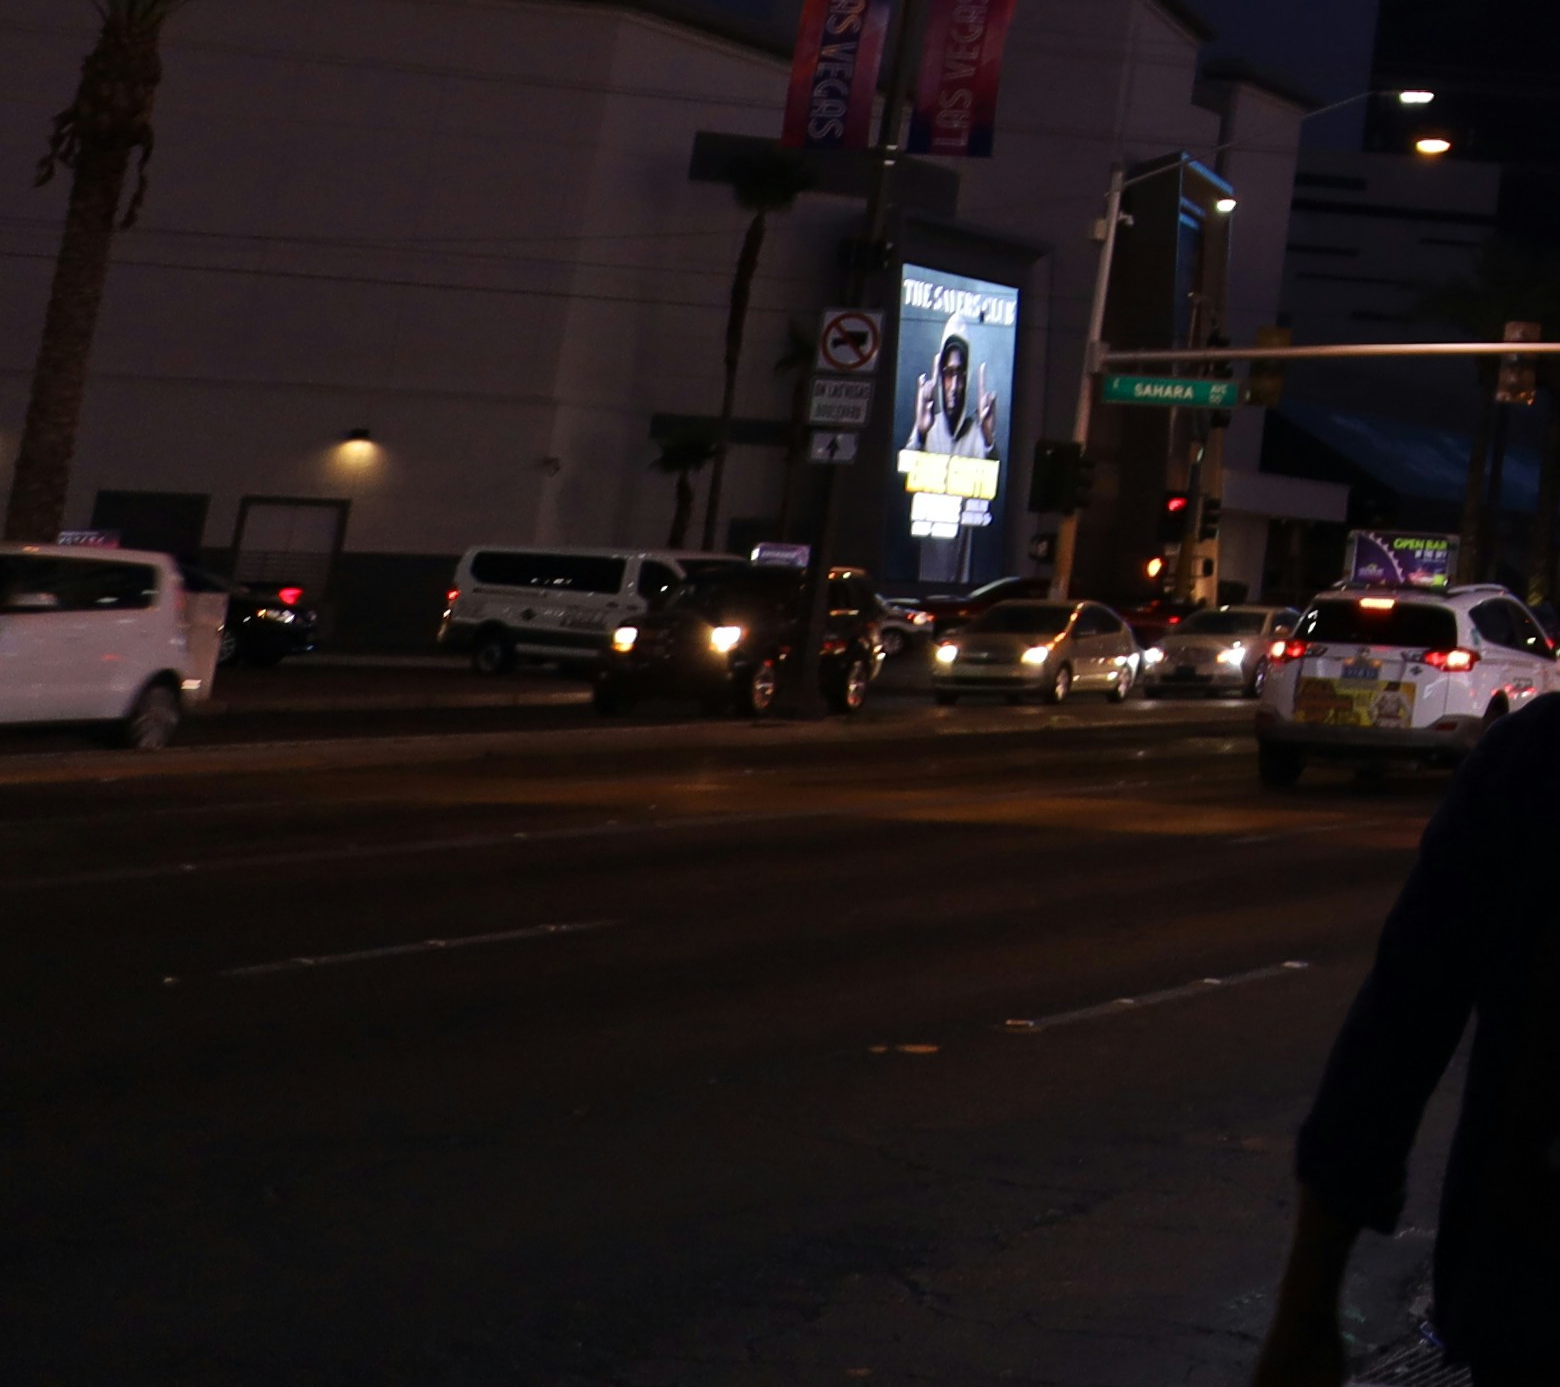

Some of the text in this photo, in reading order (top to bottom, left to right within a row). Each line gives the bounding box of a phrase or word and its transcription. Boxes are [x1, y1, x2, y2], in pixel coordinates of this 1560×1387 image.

[807, 40, 859, 140] VEGAS
[931, 87, 974, 148] LAS
[904, 278, 933, 310] THE
[1134, 382, 1195, 400] SAHARA
